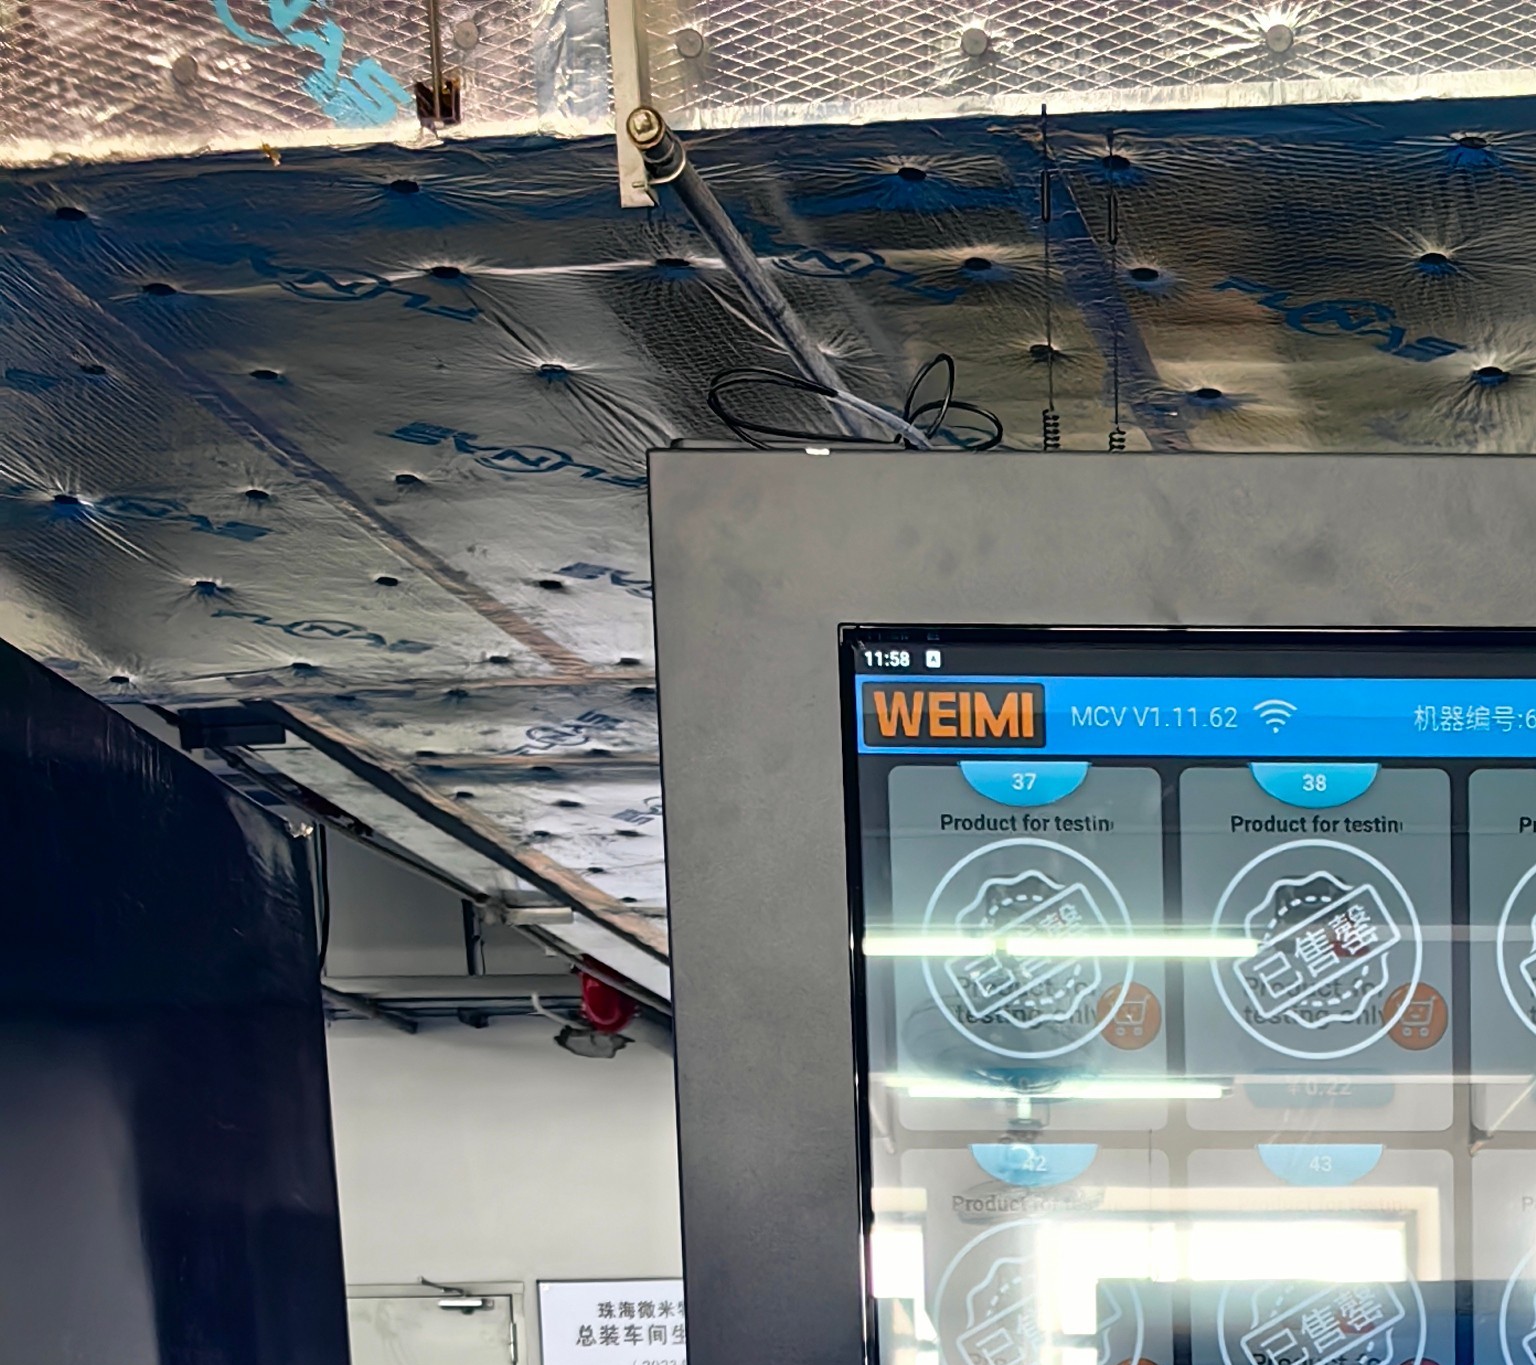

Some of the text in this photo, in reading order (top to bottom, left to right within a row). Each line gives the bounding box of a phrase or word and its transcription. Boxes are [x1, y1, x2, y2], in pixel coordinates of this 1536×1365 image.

[864, 651, 910, 667] 11:58
[873, 691, 1035, 738] WEIMI
[1072, 706, 1238, 728] MCV V1.11.62
[1012, 773, 1036, 791] 37
[1302, 774, 1327, 792] 38
[941, 814, 1113, 832] Product for testin
[1231, 815, 1402, 833] Product for testin
[1253, 903, 1378, 997] 已售罄
[1310, 1156, 1332, 1172] 43
